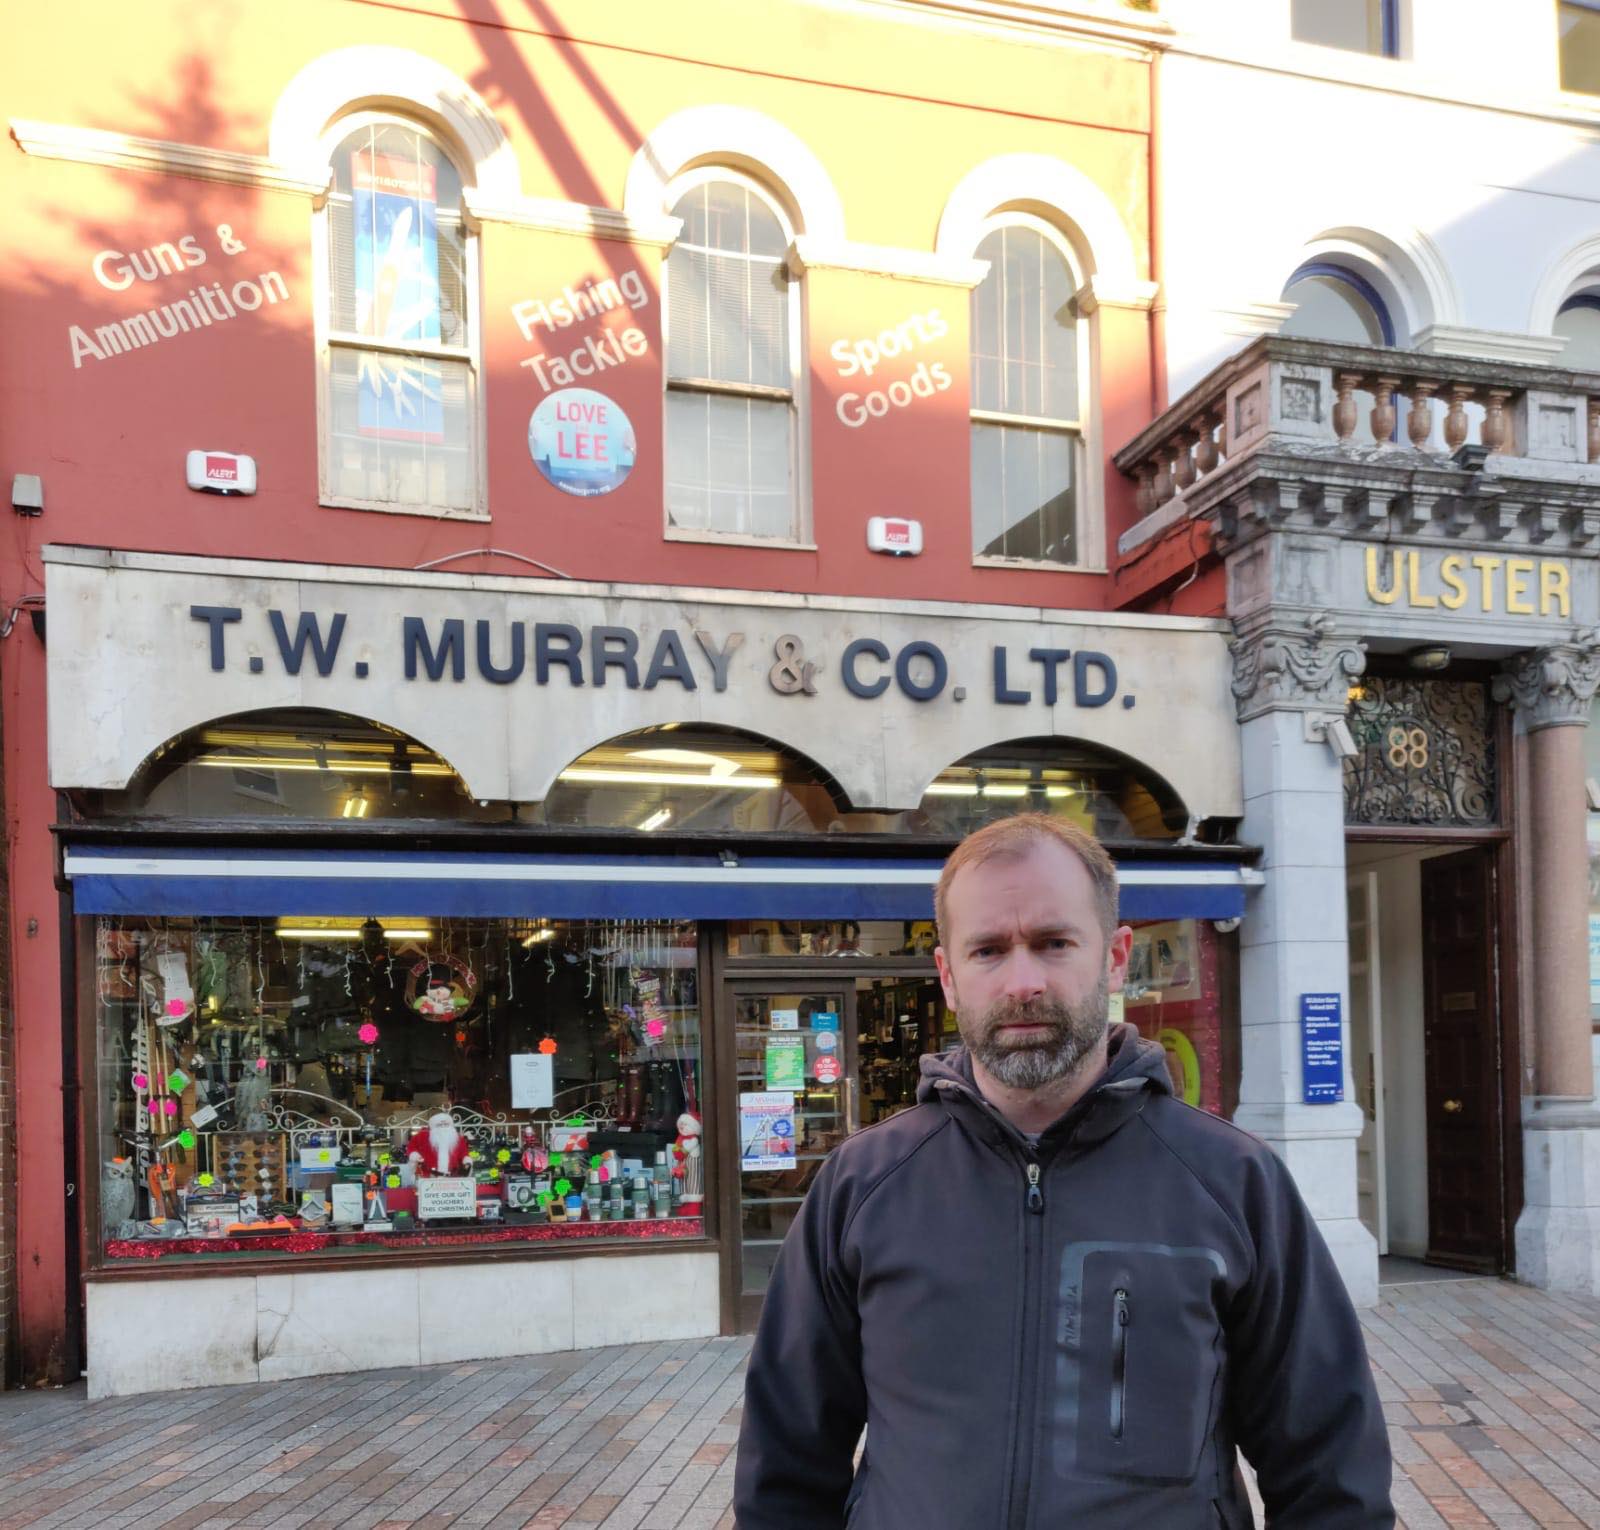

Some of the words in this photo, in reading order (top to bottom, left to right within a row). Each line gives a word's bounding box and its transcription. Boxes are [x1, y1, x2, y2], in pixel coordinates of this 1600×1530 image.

[92, 235, 207, 292] Guns
[216, 223, 247, 256] &
[68, 269, 291, 369] Ammunition
[511, 270, 649, 342] Fishing
[519, 327, 649, 392] Tackle
[830, 308, 949, 377] Sports
[556, 400, 608, 425] LOVE
[836, 361, 953, 428] Goods
[207, 468, 236, 479] ALERT
[557, 431, 609, 462] LEE
[1364, 544, 1571, 617] ULSTER
[190, 604, 369, 679] T.W.
[402, 616, 745, 693] MURRAY
[768, 633, 819, 696] &
[840, 637, 967, 702] CO.
[993, 645, 1136, 709] LTD.
[1388, 726, 1428, 768] 88
